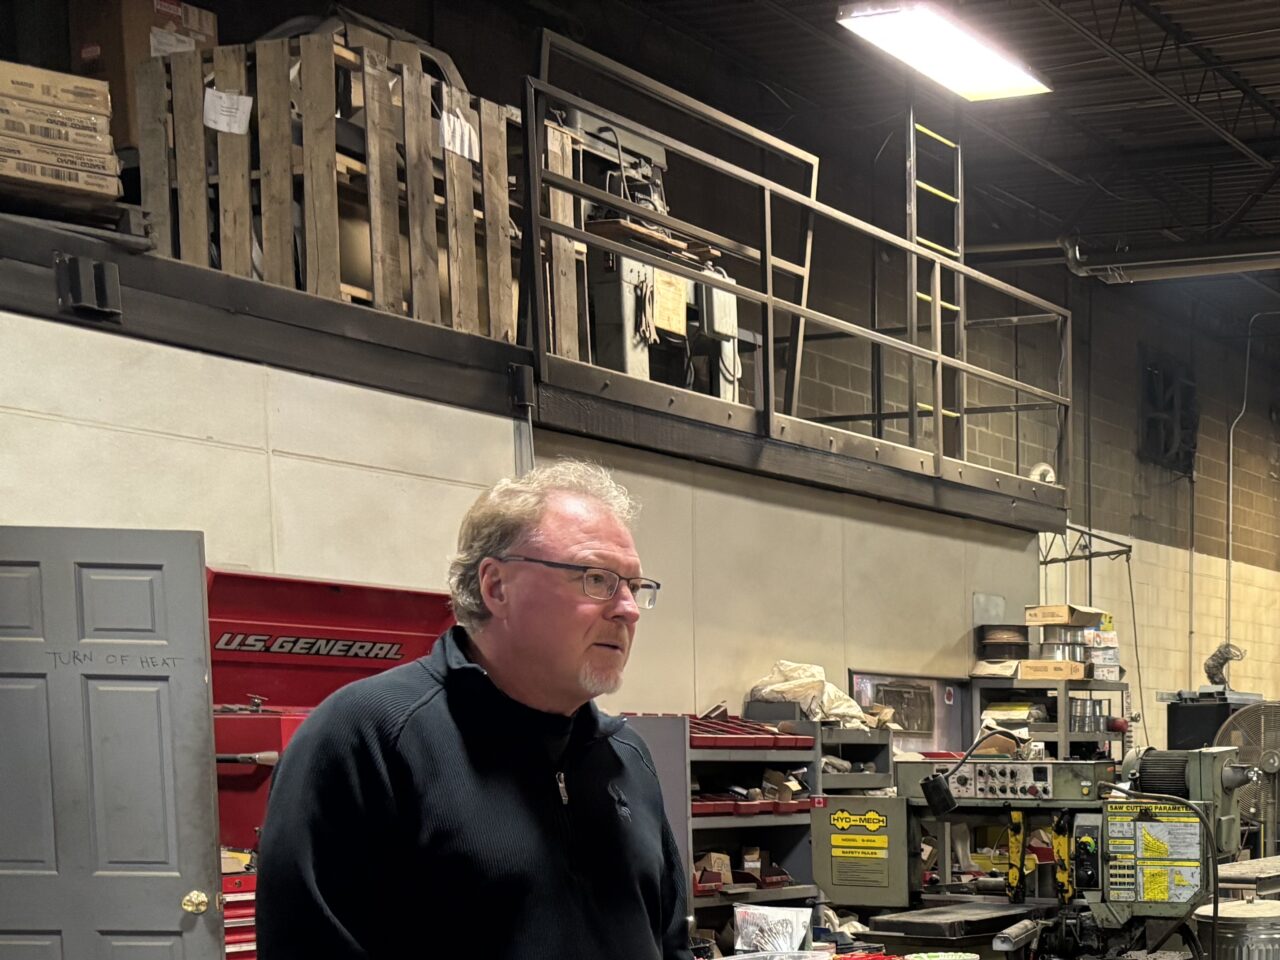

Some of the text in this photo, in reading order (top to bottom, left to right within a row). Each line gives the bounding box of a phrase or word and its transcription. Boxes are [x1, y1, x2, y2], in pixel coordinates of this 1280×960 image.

[269, 636, 404, 660] GENERAL
[45, 650, 185, 670] TURN OF HEAT
